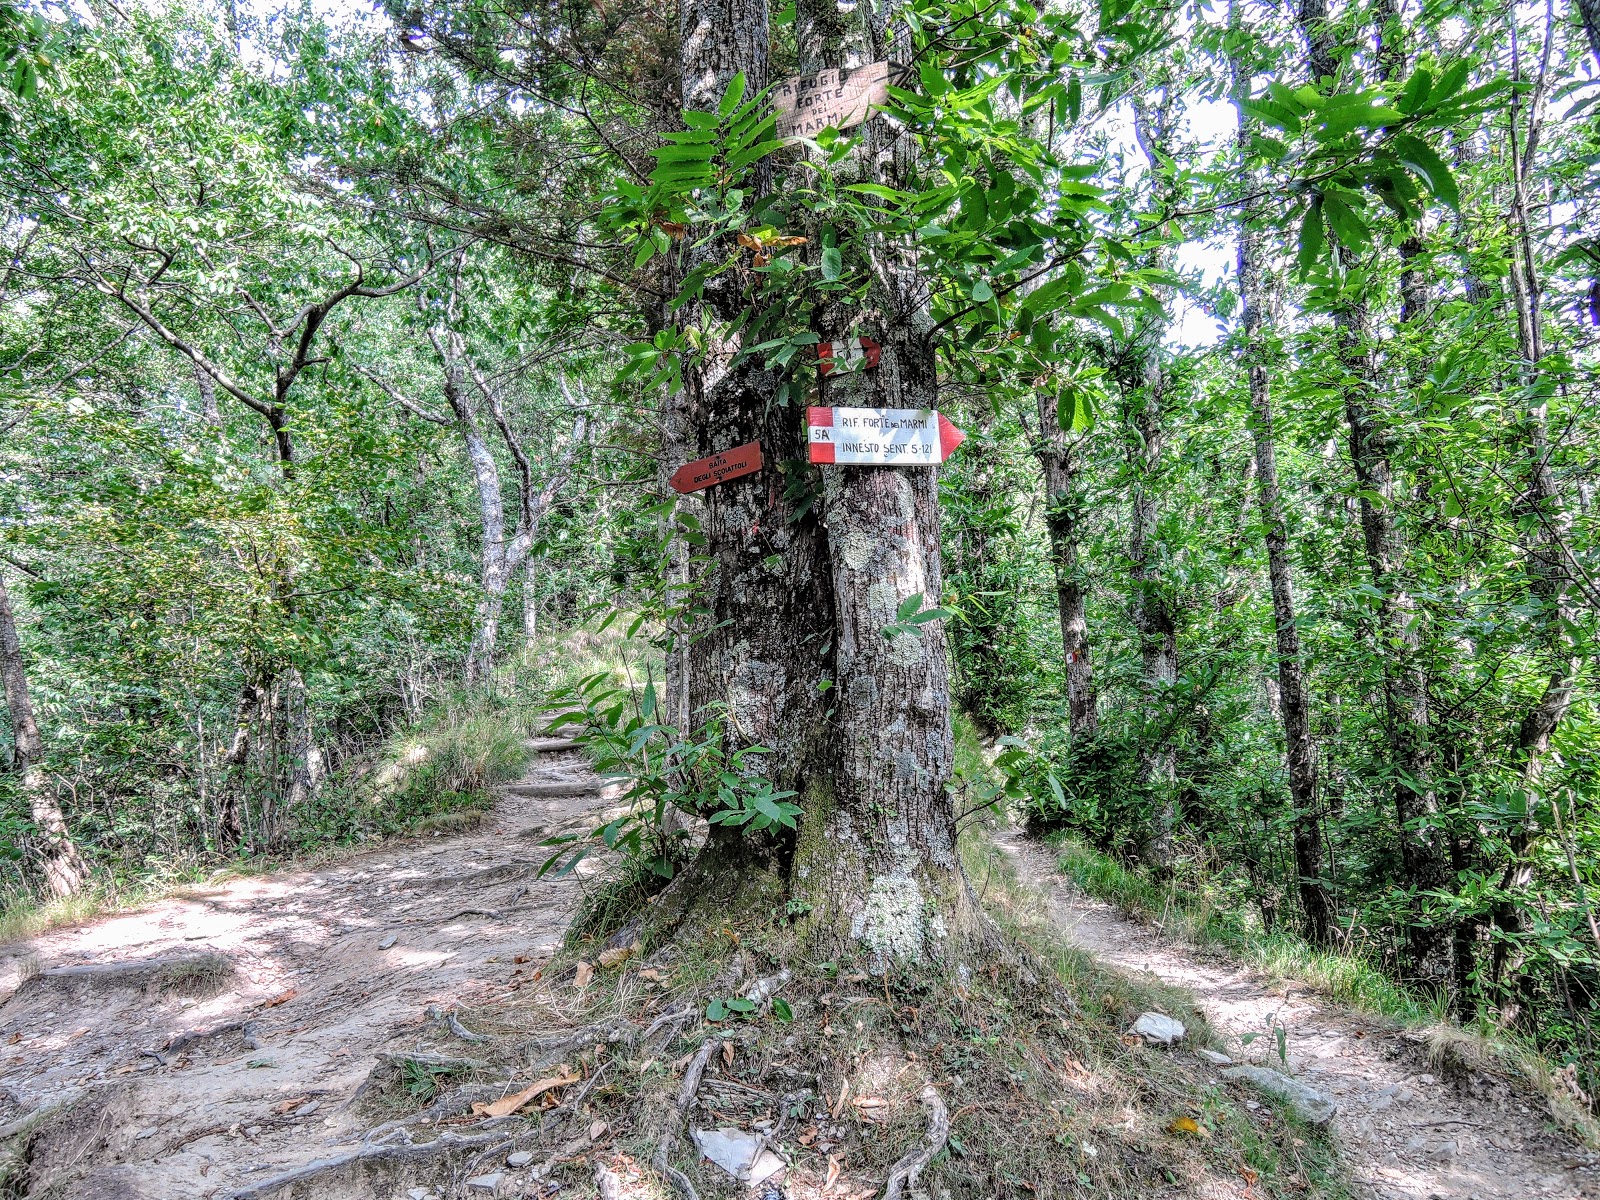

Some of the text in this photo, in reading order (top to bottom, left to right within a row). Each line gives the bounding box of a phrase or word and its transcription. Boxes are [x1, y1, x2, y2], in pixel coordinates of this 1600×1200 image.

[797, 88, 843, 109] FORTE
[812, 103, 827, 116] DEI
[791, 107, 844, 135] MARMI
[863, 417, 889, 429] FORTE
[900, 419, 927, 429] MARMI
[814, 429, 829, 440] 5A
[842, 443, 879, 453] INNESTO
[708, 458, 727, 470] BAITA
[694, 461, 747, 484] DEGLI SCOIATTOLI
